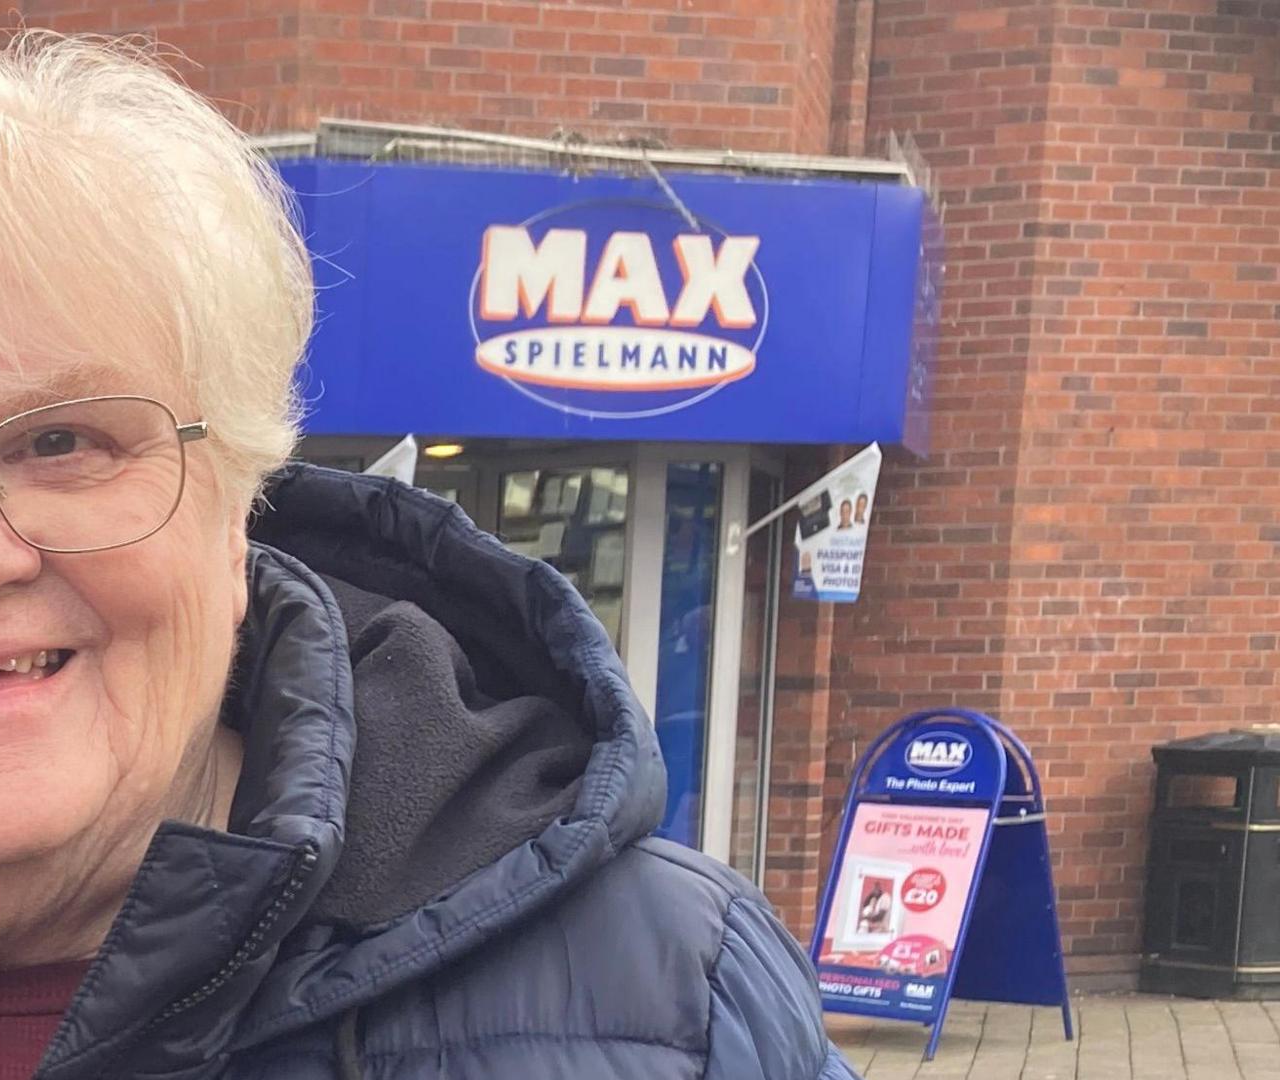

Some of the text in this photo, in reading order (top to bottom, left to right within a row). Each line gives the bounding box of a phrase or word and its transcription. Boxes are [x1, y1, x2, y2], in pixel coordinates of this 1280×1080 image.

[480, 224, 760, 328] MAX
[504, 340, 729, 372] SPIELMANN
[910, 740, 968, 761] MAX
[886, 776, 975, 793] The Photo Expert
[864, 820, 970, 840] GIFTS MADE
